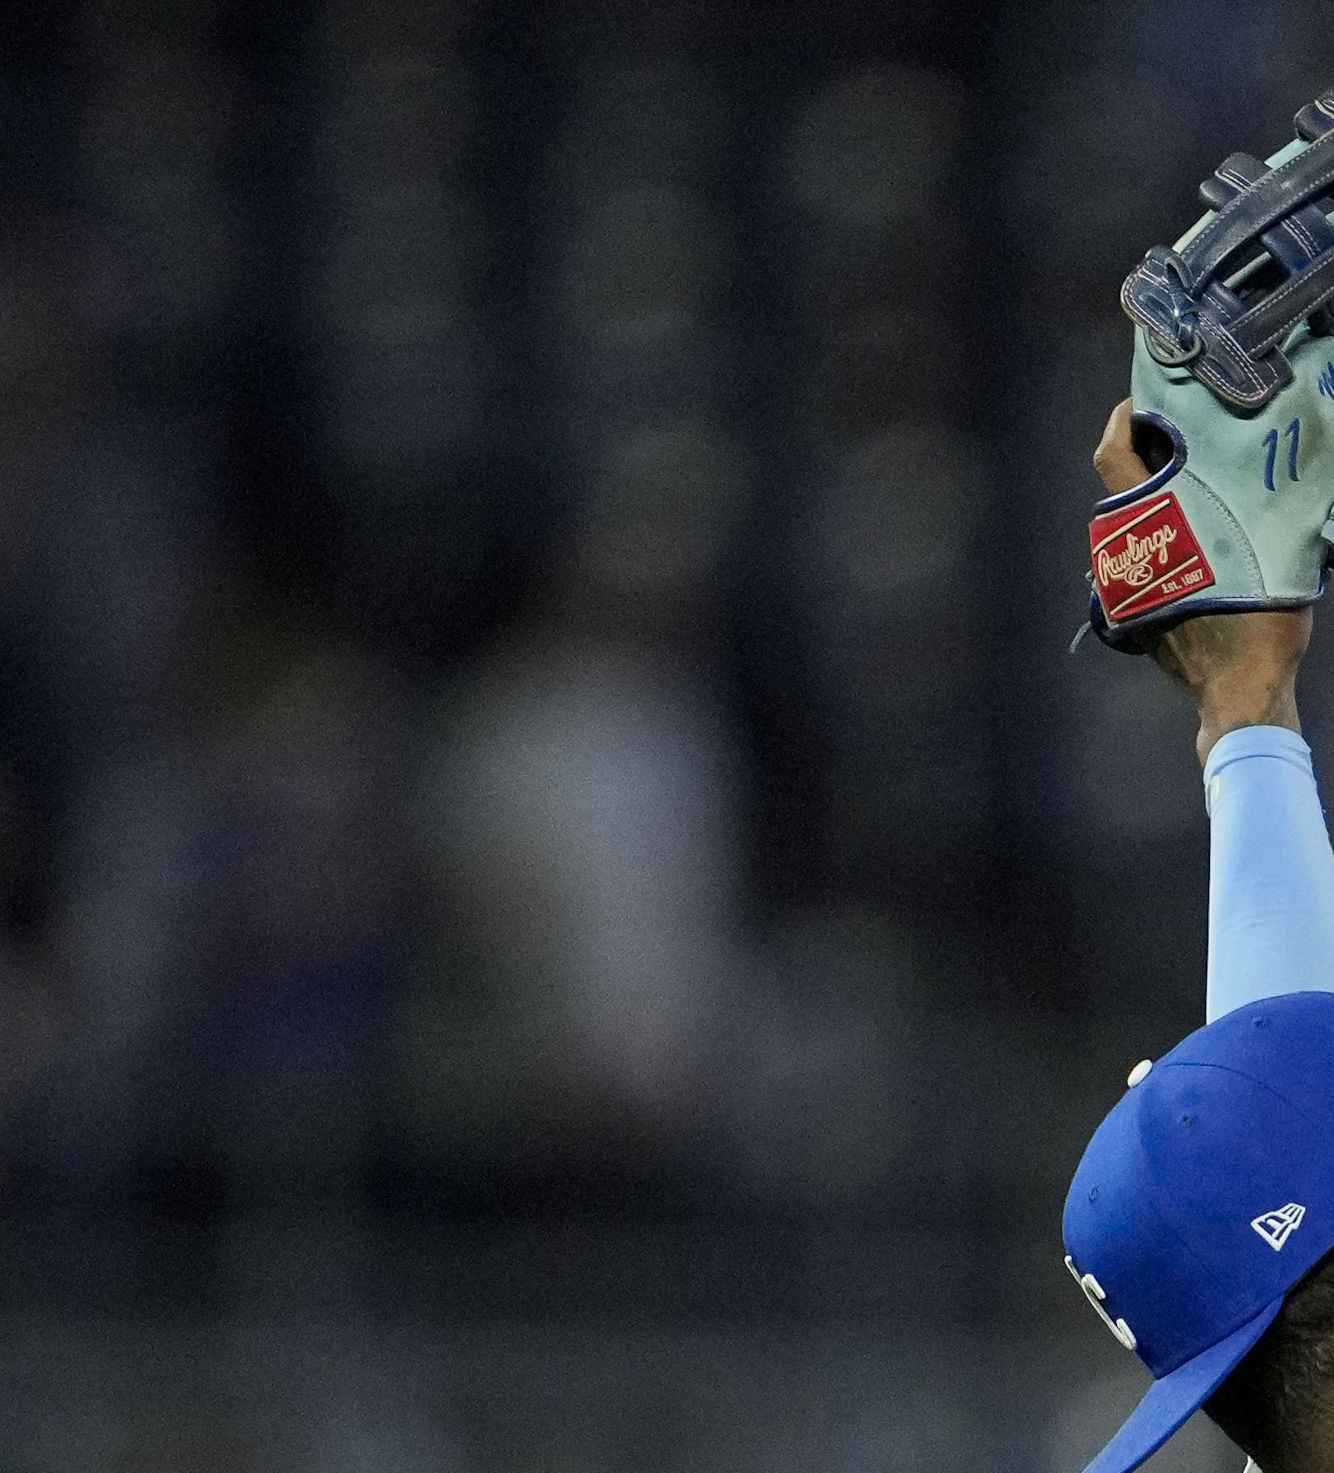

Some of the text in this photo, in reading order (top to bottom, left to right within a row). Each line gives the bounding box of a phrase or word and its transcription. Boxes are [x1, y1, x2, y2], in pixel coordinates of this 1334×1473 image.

[1261, 417, 1301, 492] 11
[1098, 524, 1178, 587] Rawlings
[1161, 580, 1183, 594] Est.
